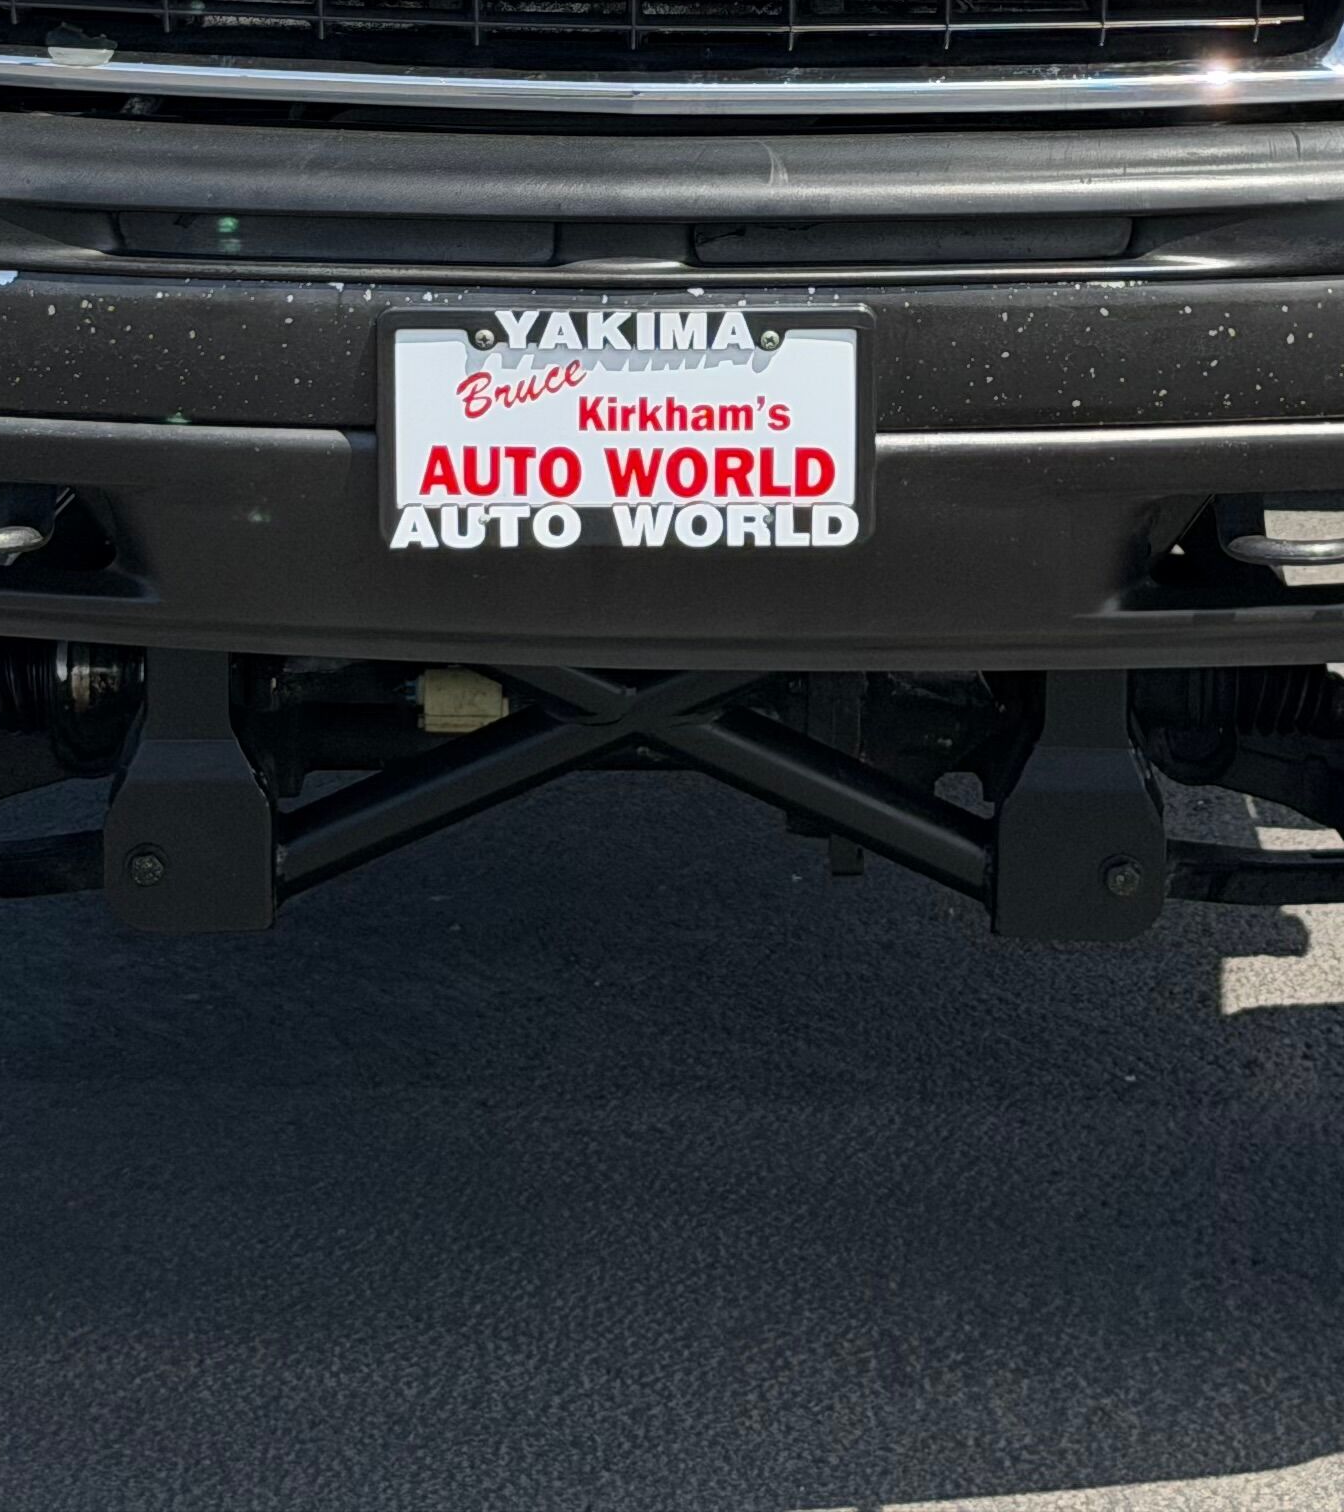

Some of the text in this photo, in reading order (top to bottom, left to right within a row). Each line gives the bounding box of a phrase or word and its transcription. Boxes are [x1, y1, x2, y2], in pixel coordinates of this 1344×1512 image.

[495, 310, 754, 351] YAKIMA
[456, 359, 586, 419] Bruce
[577, 395, 791, 432] Kirkham's
[418, 445, 836, 497] AUTO WORLD
[390, 503, 859, 549] AUTO WORLD
